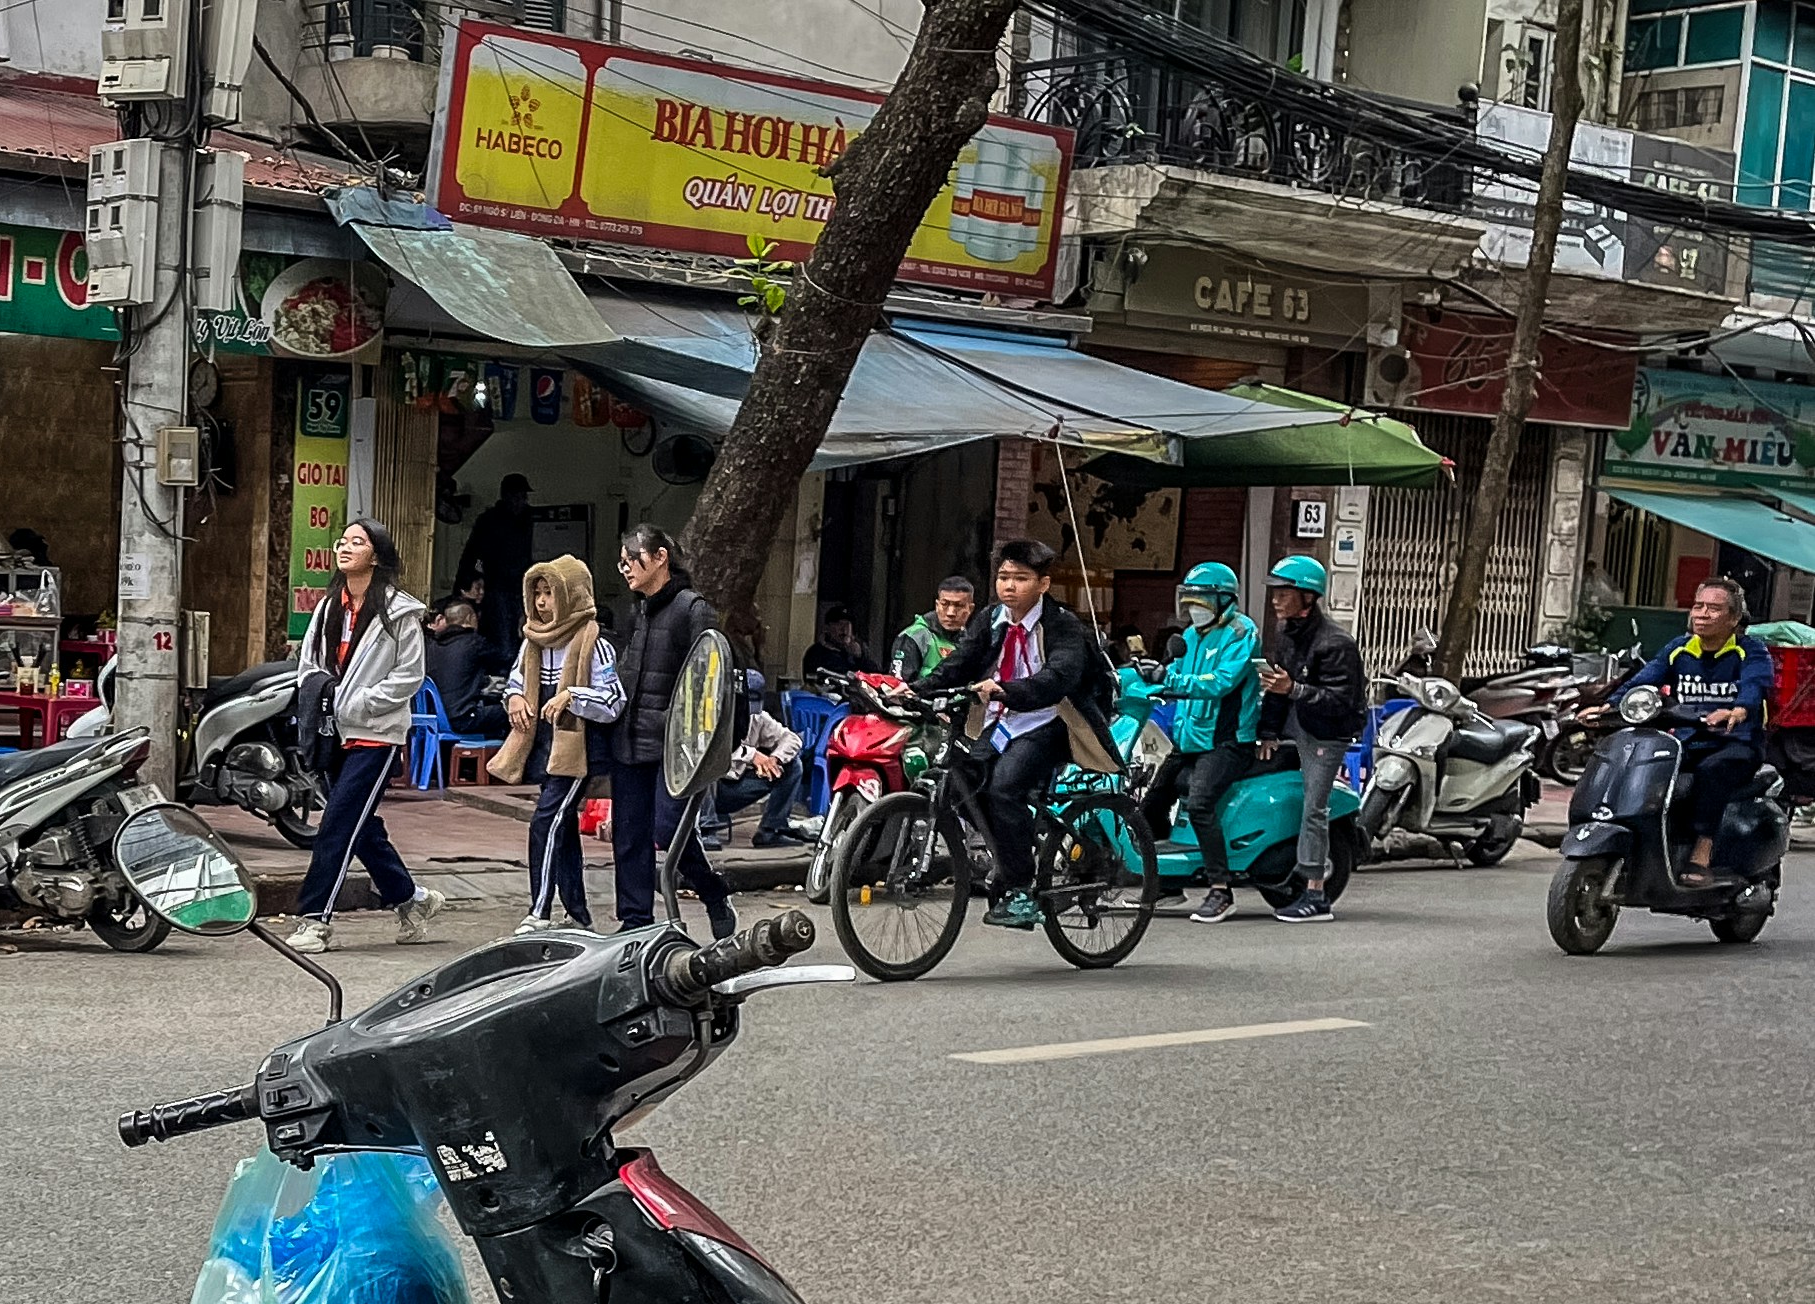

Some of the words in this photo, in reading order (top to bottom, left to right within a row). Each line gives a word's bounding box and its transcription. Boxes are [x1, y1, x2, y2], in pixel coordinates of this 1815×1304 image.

[651, 98, 716, 150] BIA
[475, 127, 563, 160] HABECO
[684, 172, 756, 213] QUÁN
[757, 186, 803, 223] LỢI
[1194, 276, 1273, 317] CAFE
[1283, 287, 1309, 321] 63
[307, 389, 343, 423] 59
[1652, 422, 1717, 459] VĂN
[1304, 504, 1321, 524] 63
[153, 631, 174, 651] 12
